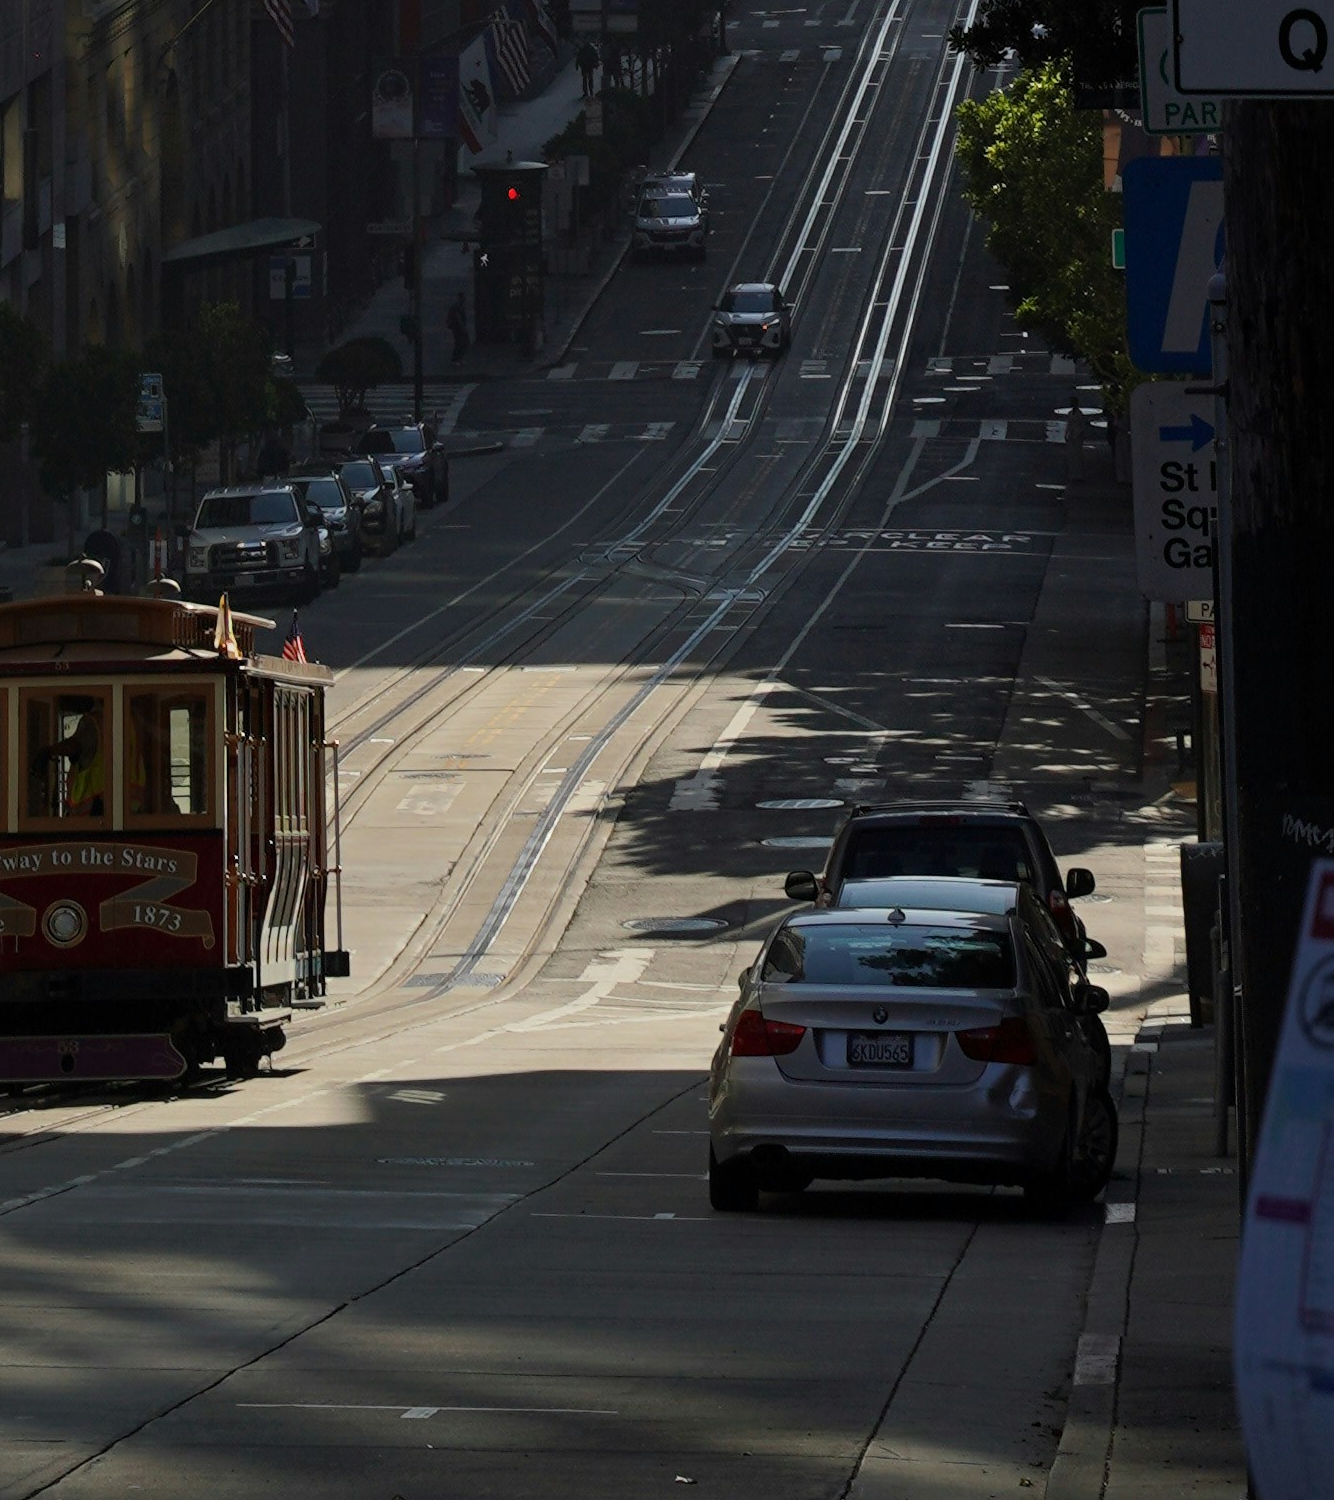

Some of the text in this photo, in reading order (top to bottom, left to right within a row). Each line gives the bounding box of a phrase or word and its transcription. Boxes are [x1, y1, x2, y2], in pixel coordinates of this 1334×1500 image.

[1160, 461, 1199, 492] St
[890, 540, 1013, 550] KEEP
[51, 849, 72, 866] to
[81, 847, 114, 866] the
[121, 848, 178, 874] Stars
[133, 905, 183, 931] 1873
[851, 1043, 908, 1060] 6KDU565
